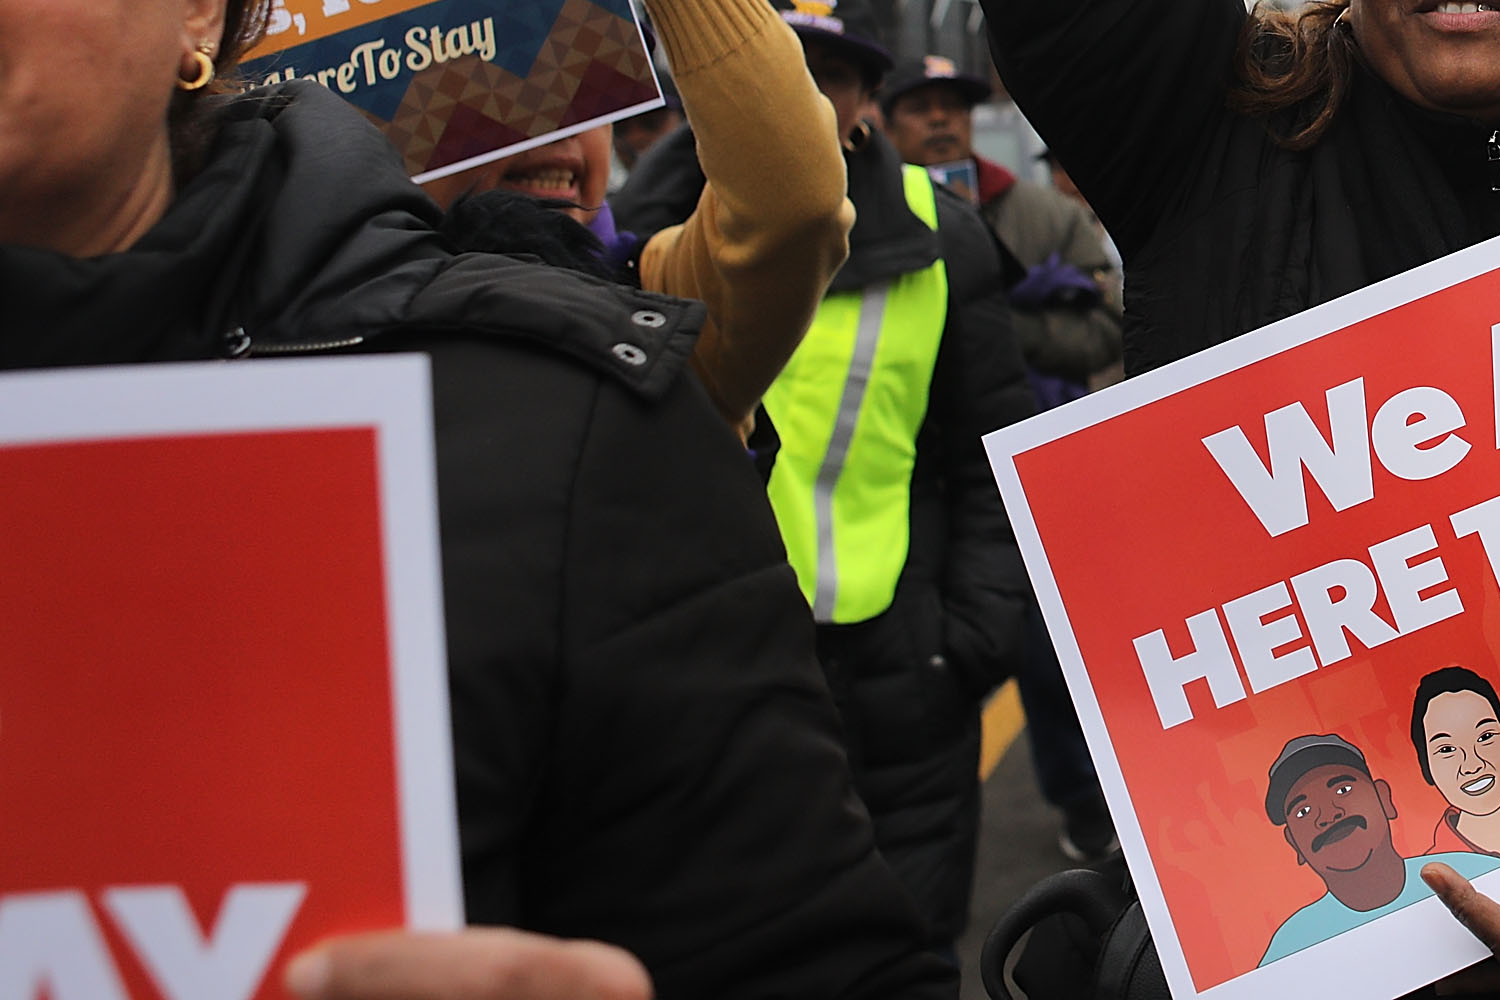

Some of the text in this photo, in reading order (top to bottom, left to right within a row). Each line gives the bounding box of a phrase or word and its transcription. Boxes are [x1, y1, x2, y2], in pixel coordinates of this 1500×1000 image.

[1200, 376, 1472, 538] We
[1132, 523, 1465, 731] HERE
[0, 882, 309, 1000] AY
